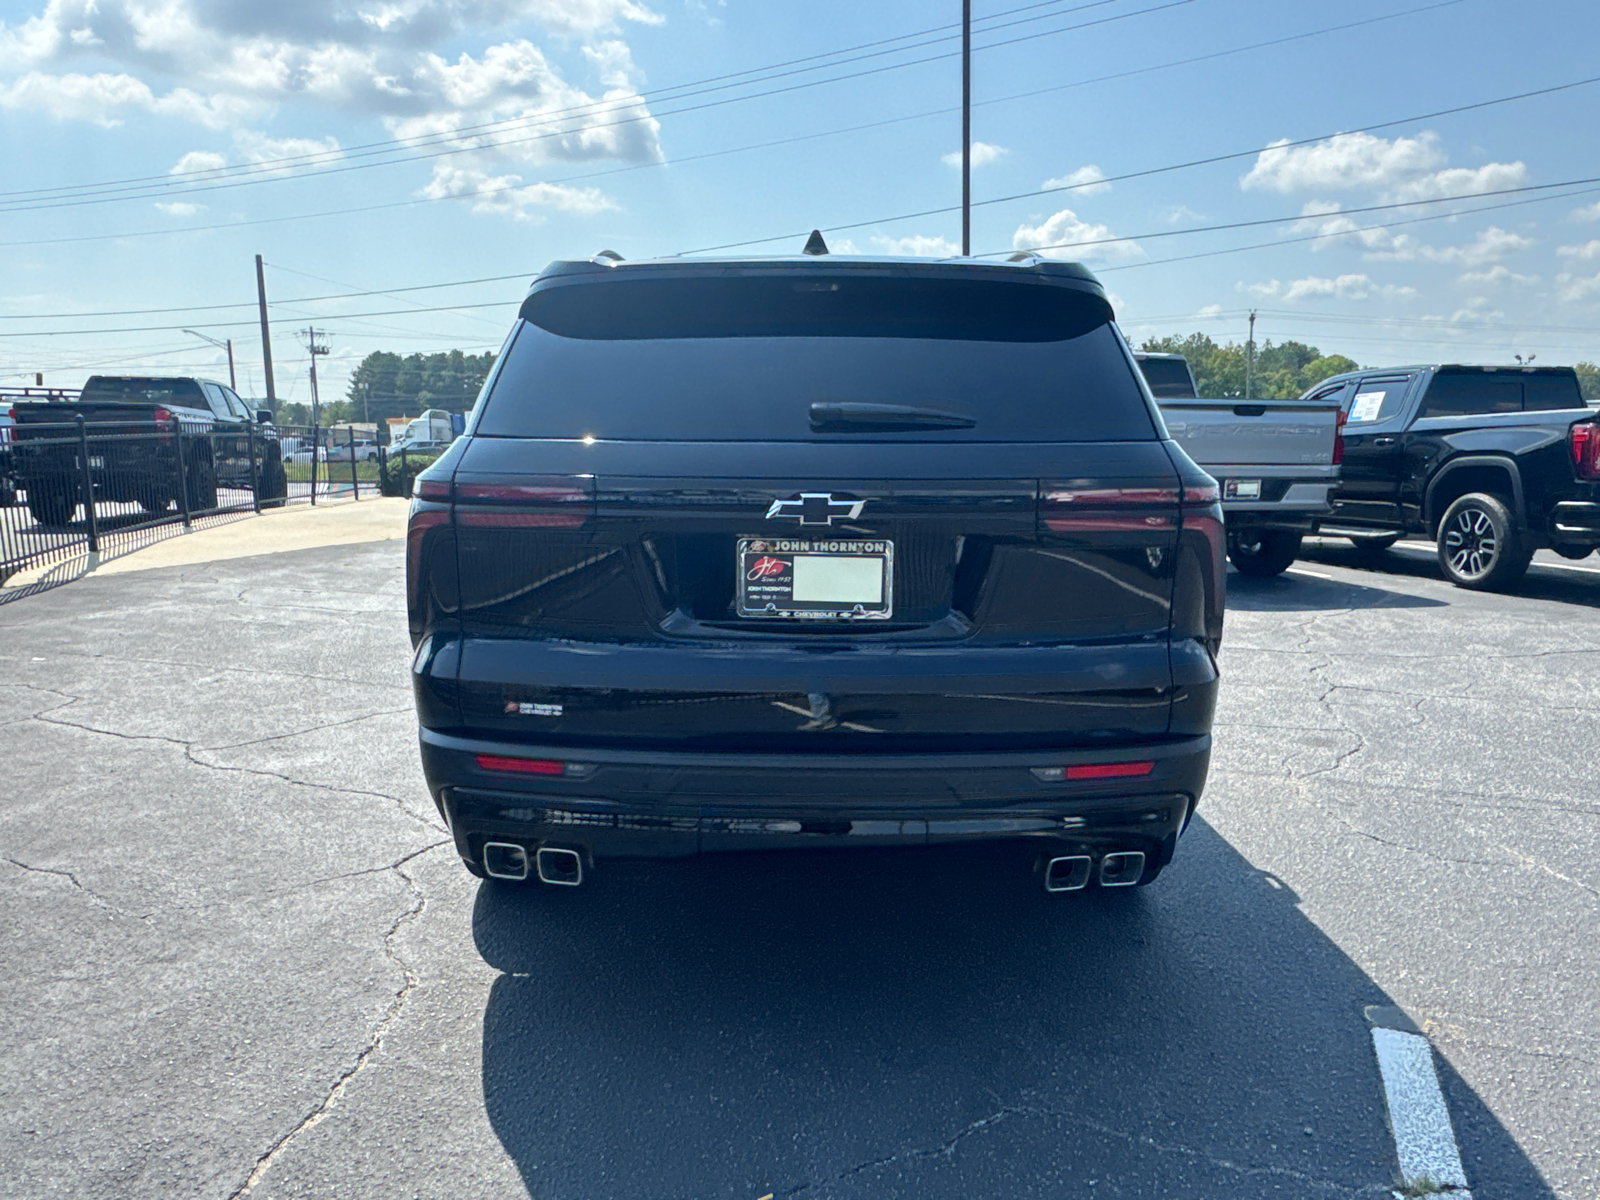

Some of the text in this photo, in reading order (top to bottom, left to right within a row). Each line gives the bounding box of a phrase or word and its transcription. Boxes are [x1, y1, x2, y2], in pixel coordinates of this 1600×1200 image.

[774, 541, 884, 552] JOHN THORNTON
[793, 610, 838, 618] CHEVROLET
